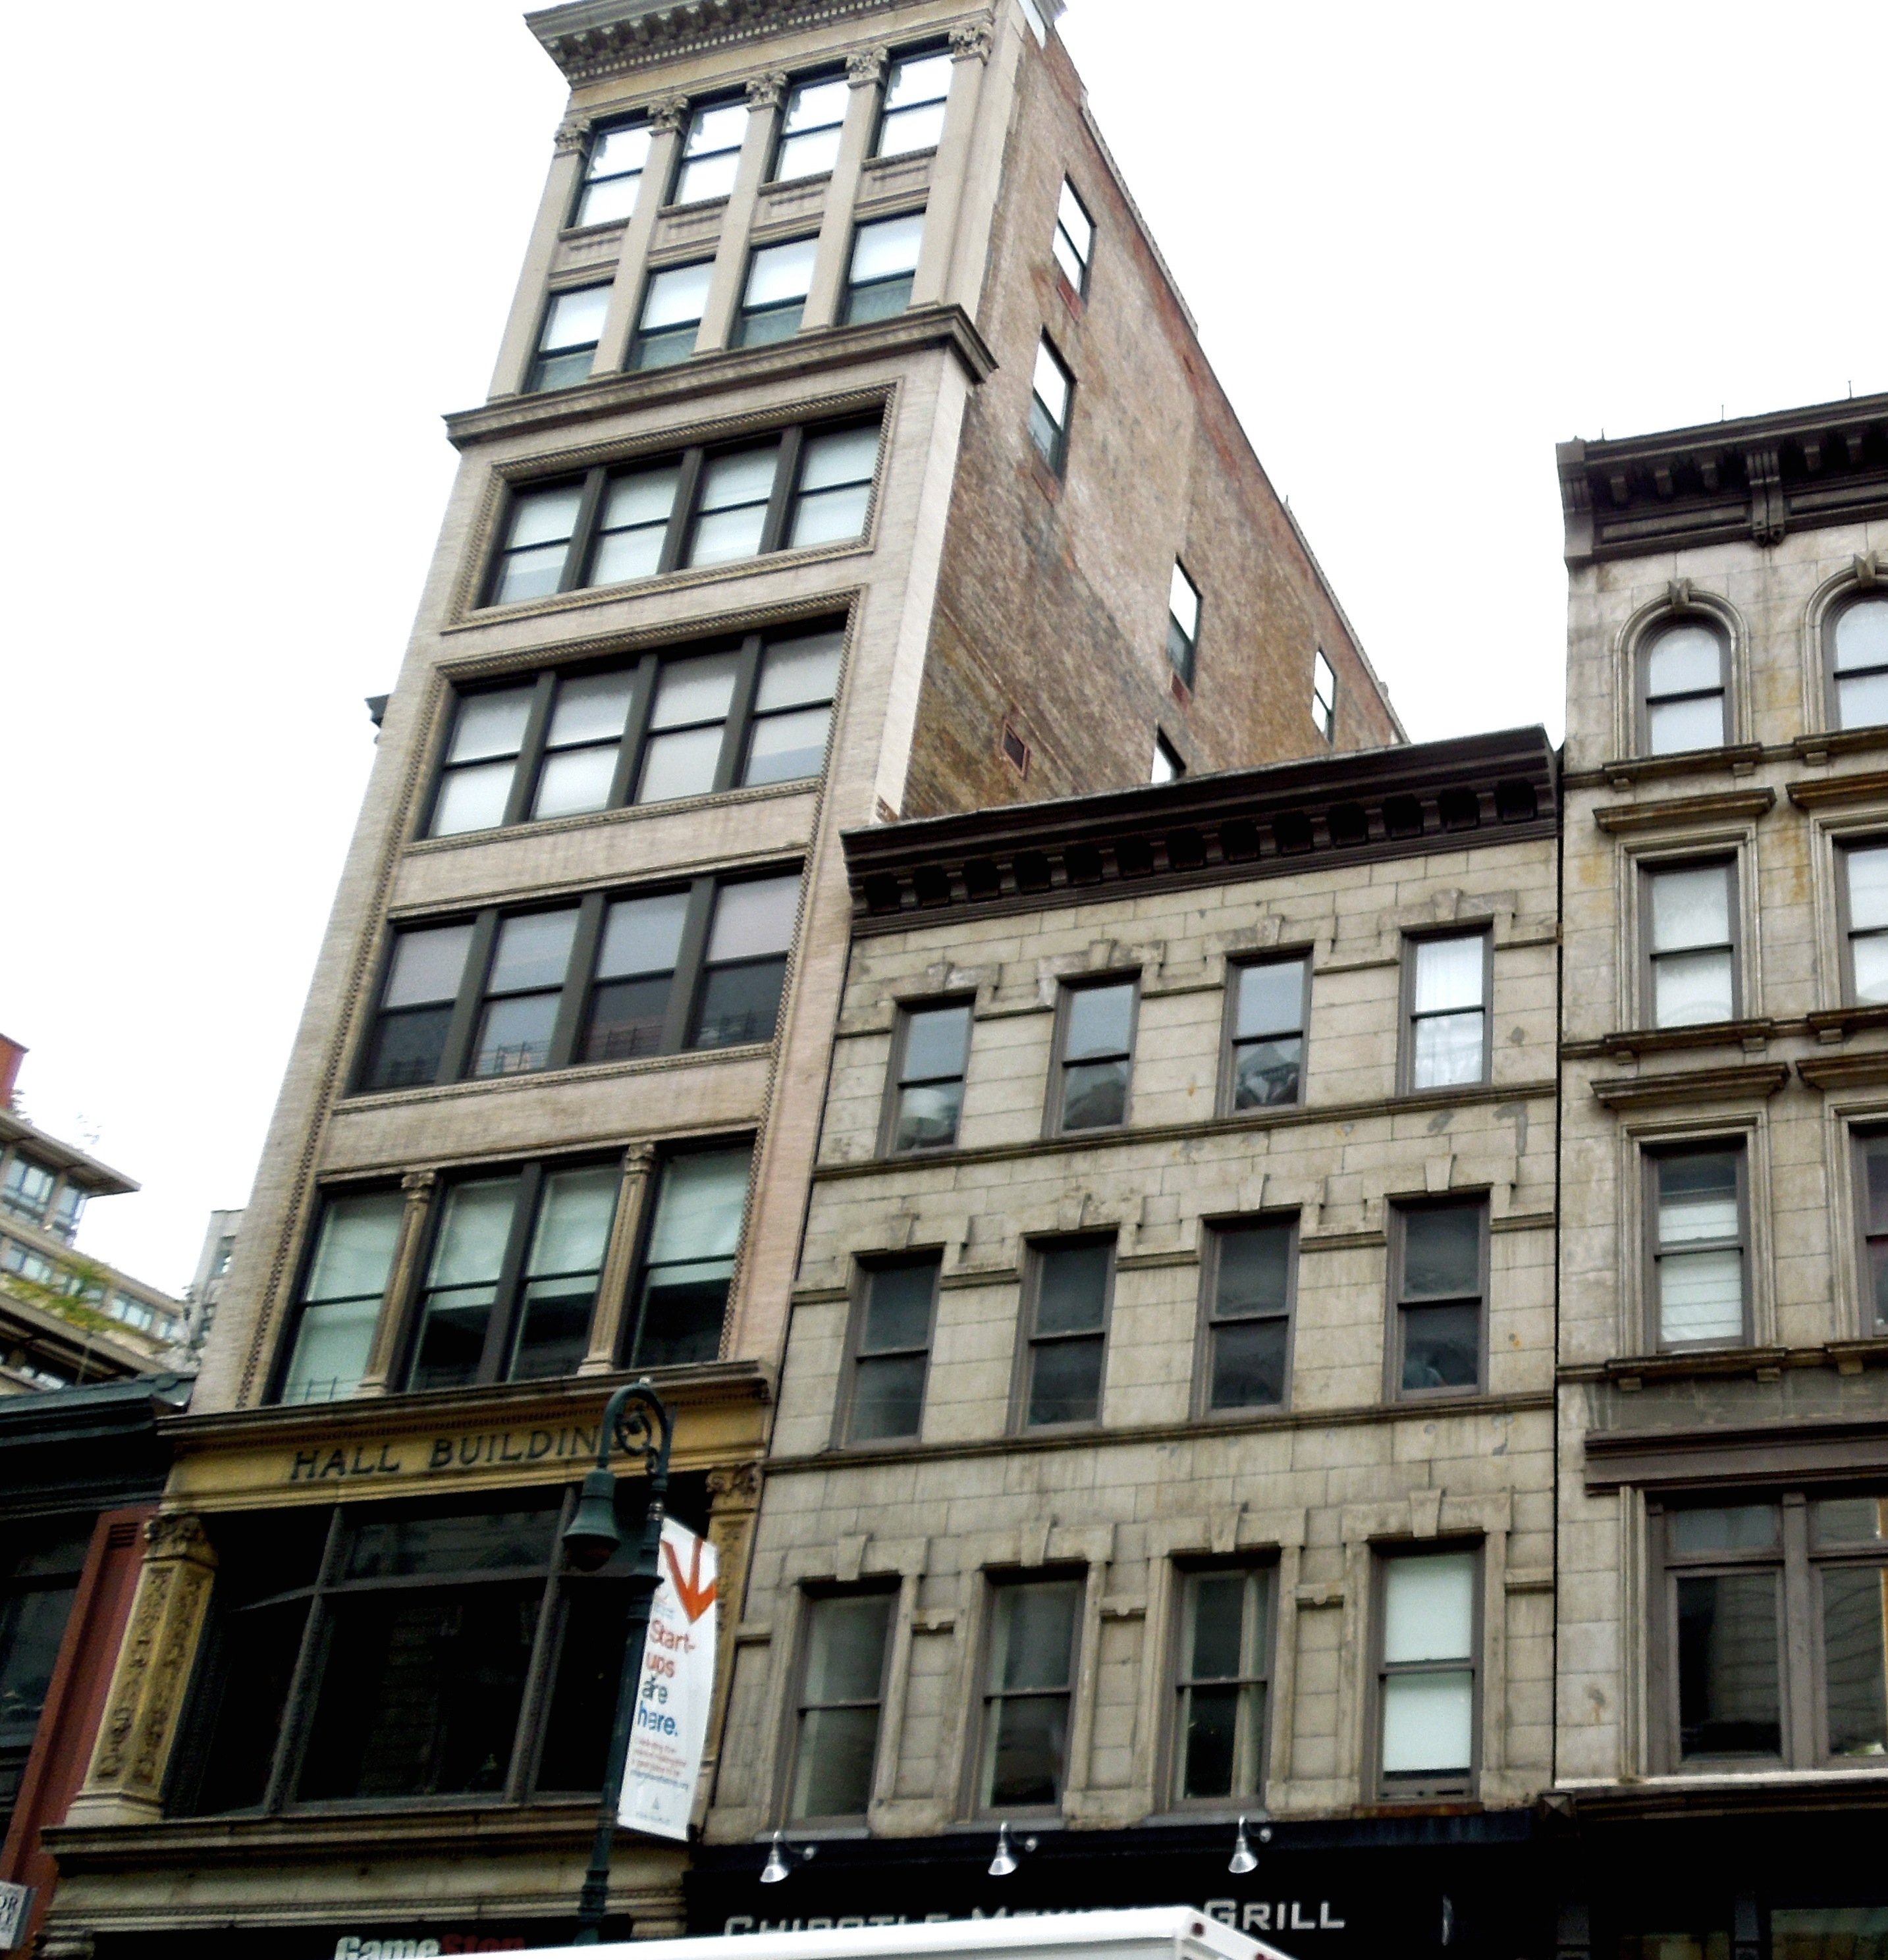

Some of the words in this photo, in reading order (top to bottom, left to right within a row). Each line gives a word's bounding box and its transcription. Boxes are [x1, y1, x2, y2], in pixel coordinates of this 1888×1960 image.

[290, 1443, 401, 1481] HALL
[429, 1424, 623, 1470] BUILDIN
[1204, 1899, 1345, 1931] GRILL
